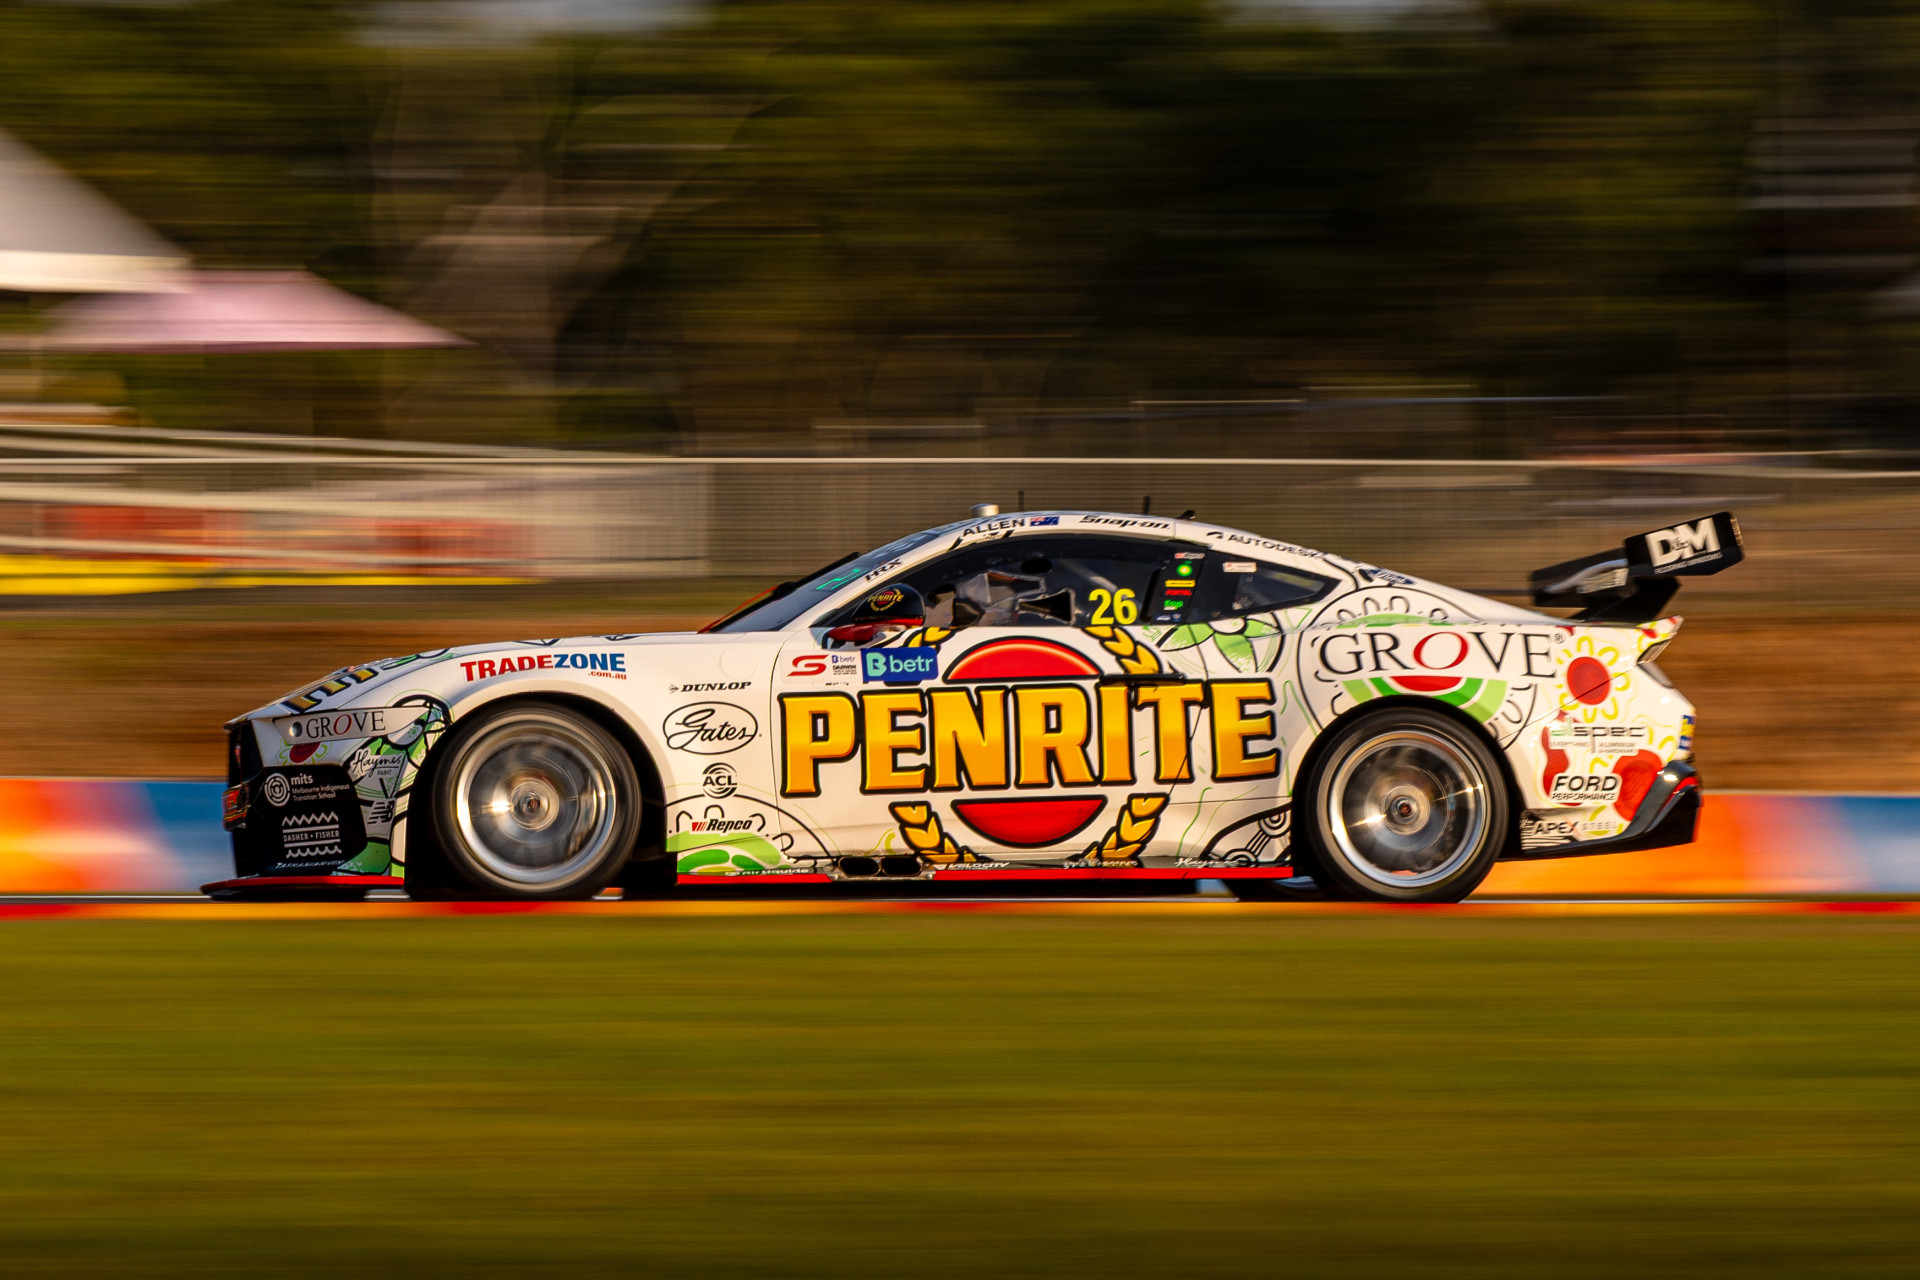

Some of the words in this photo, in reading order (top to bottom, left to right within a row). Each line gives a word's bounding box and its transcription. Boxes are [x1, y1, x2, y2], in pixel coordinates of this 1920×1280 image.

[962, 518, 1025, 538] ALLEN
[867, 593, 904, 603] PENRITE
[1088, 588, 1138, 625] 26
[1319, 631, 1557, 679] GROVE
[460, 653, 627, 682] TRADEZONE
[889, 655, 934, 673] betr
[587, 671, 628, 681] .com.au
[680, 681, 752, 693] DUNLOP
[305, 710, 386, 739] GROVE
[666, 708, 755, 751] Gates
[779, 678, 1282, 797] PENRITE
[352, 749, 402, 778] Haymes
[290, 773, 313, 785] mits
[702, 775, 738, 787] ACL
[1553, 775, 1619, 792] FORD
[291, 786, 320, 795] Melbourne
[320, 784, 350, 792] Indigenous
[318, 791, 337, 799] School
[1551, 792, 1617, 801] PERFORMANCE
[706, 818, 753, 833] Repco
[1533, 821, 1580, 836] APEX
[283, 833, 309, 842] DASHER
[315, 830, 340, 839] FISHER
